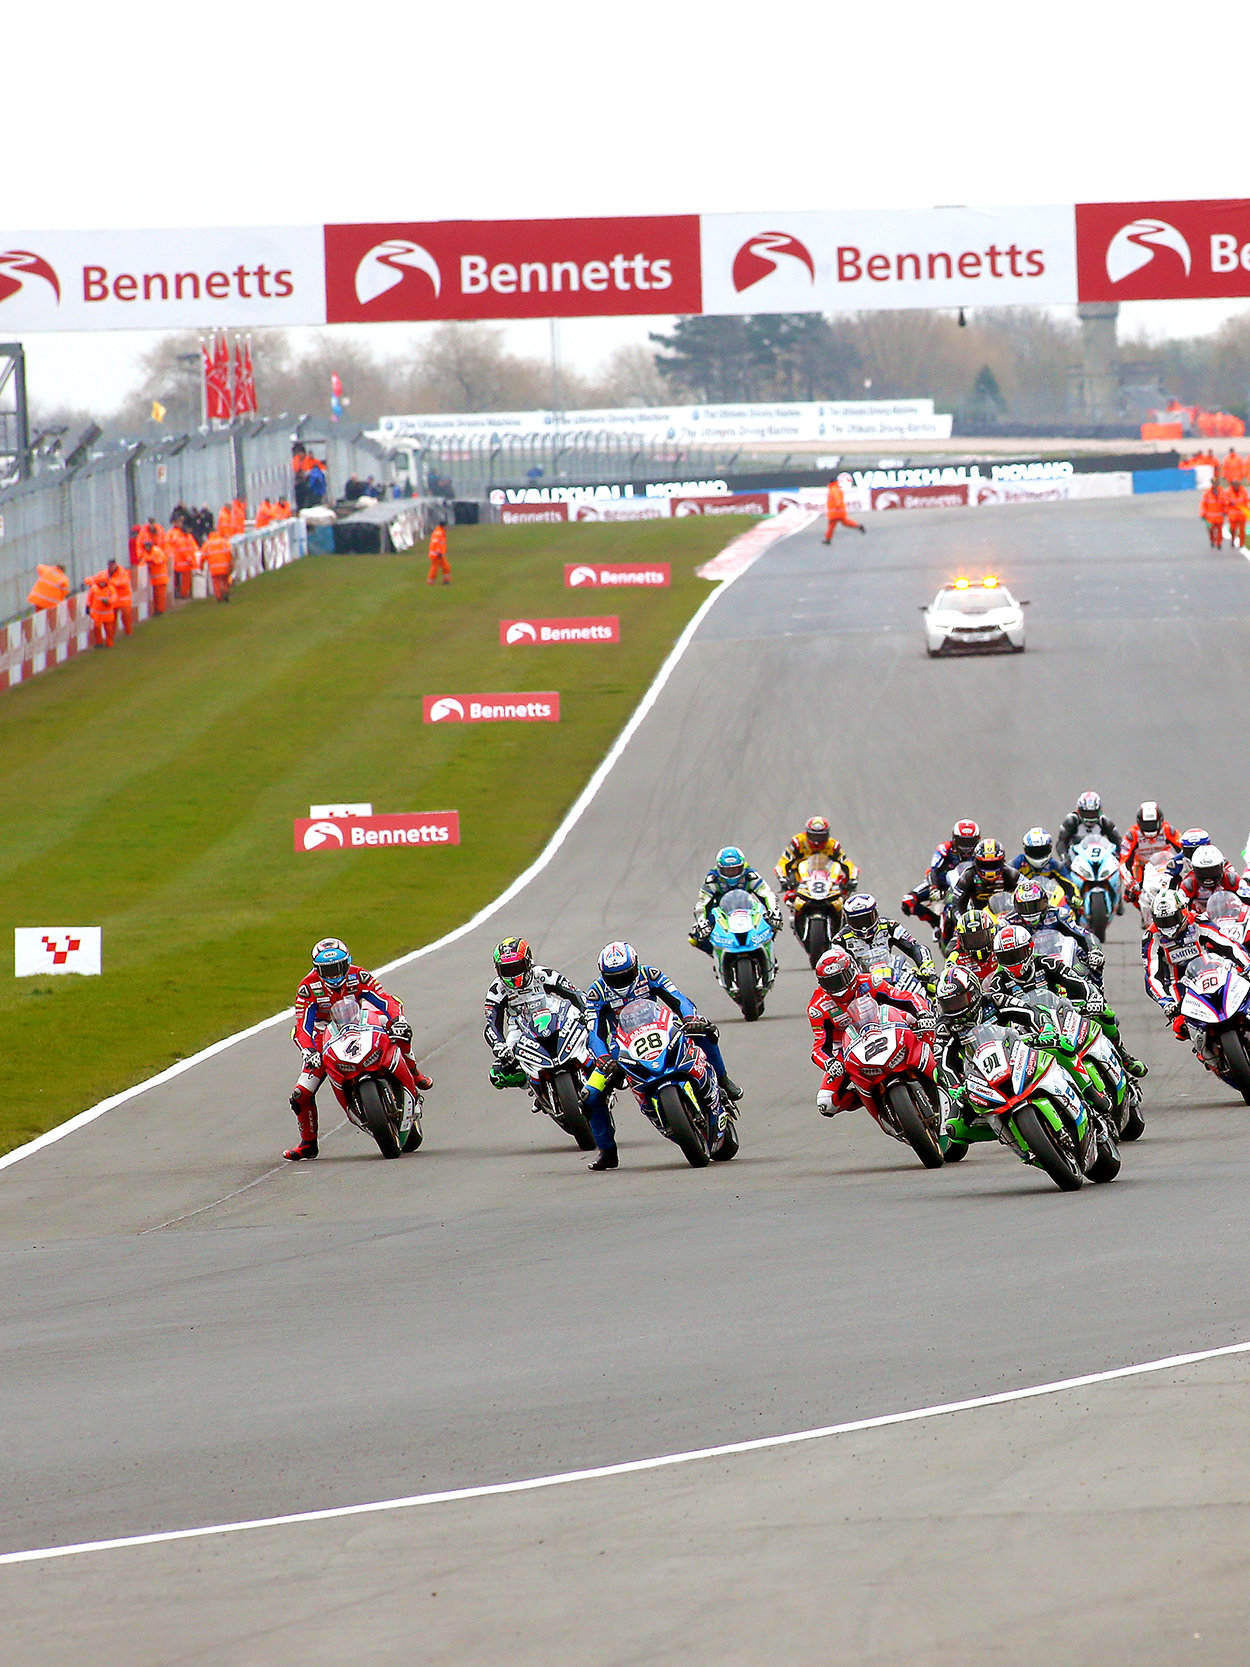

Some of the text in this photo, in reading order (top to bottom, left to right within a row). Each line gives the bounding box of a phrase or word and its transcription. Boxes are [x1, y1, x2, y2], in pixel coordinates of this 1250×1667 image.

[836, 244, 1046, 284] Bennetts
[82, 263, 294, 304] Bennetts
[460, 254, 673, 296] Bennetts
[853, 466, 986, 490] VAUXHALL
[506, 483, 635, 504] VAUXHALL
[600, 570, 665, 584] Bennetts
[540, 625, 613, 641] Bennetts
[470, 702, 551, 719] Bennetts
[350, 824, 449, 847] Bennetts
[812, 881, 826, 894] 8
[1170, 947, 1198, 961] SMITHS
[1202, 976, 1219, 991] 60
[345, 1038, 360, 1057] 4
[633, 1031, 663, 1058] 28
[864, 1036, 889, 1062] 22
[983, 1052, 1001, 1074] 91
